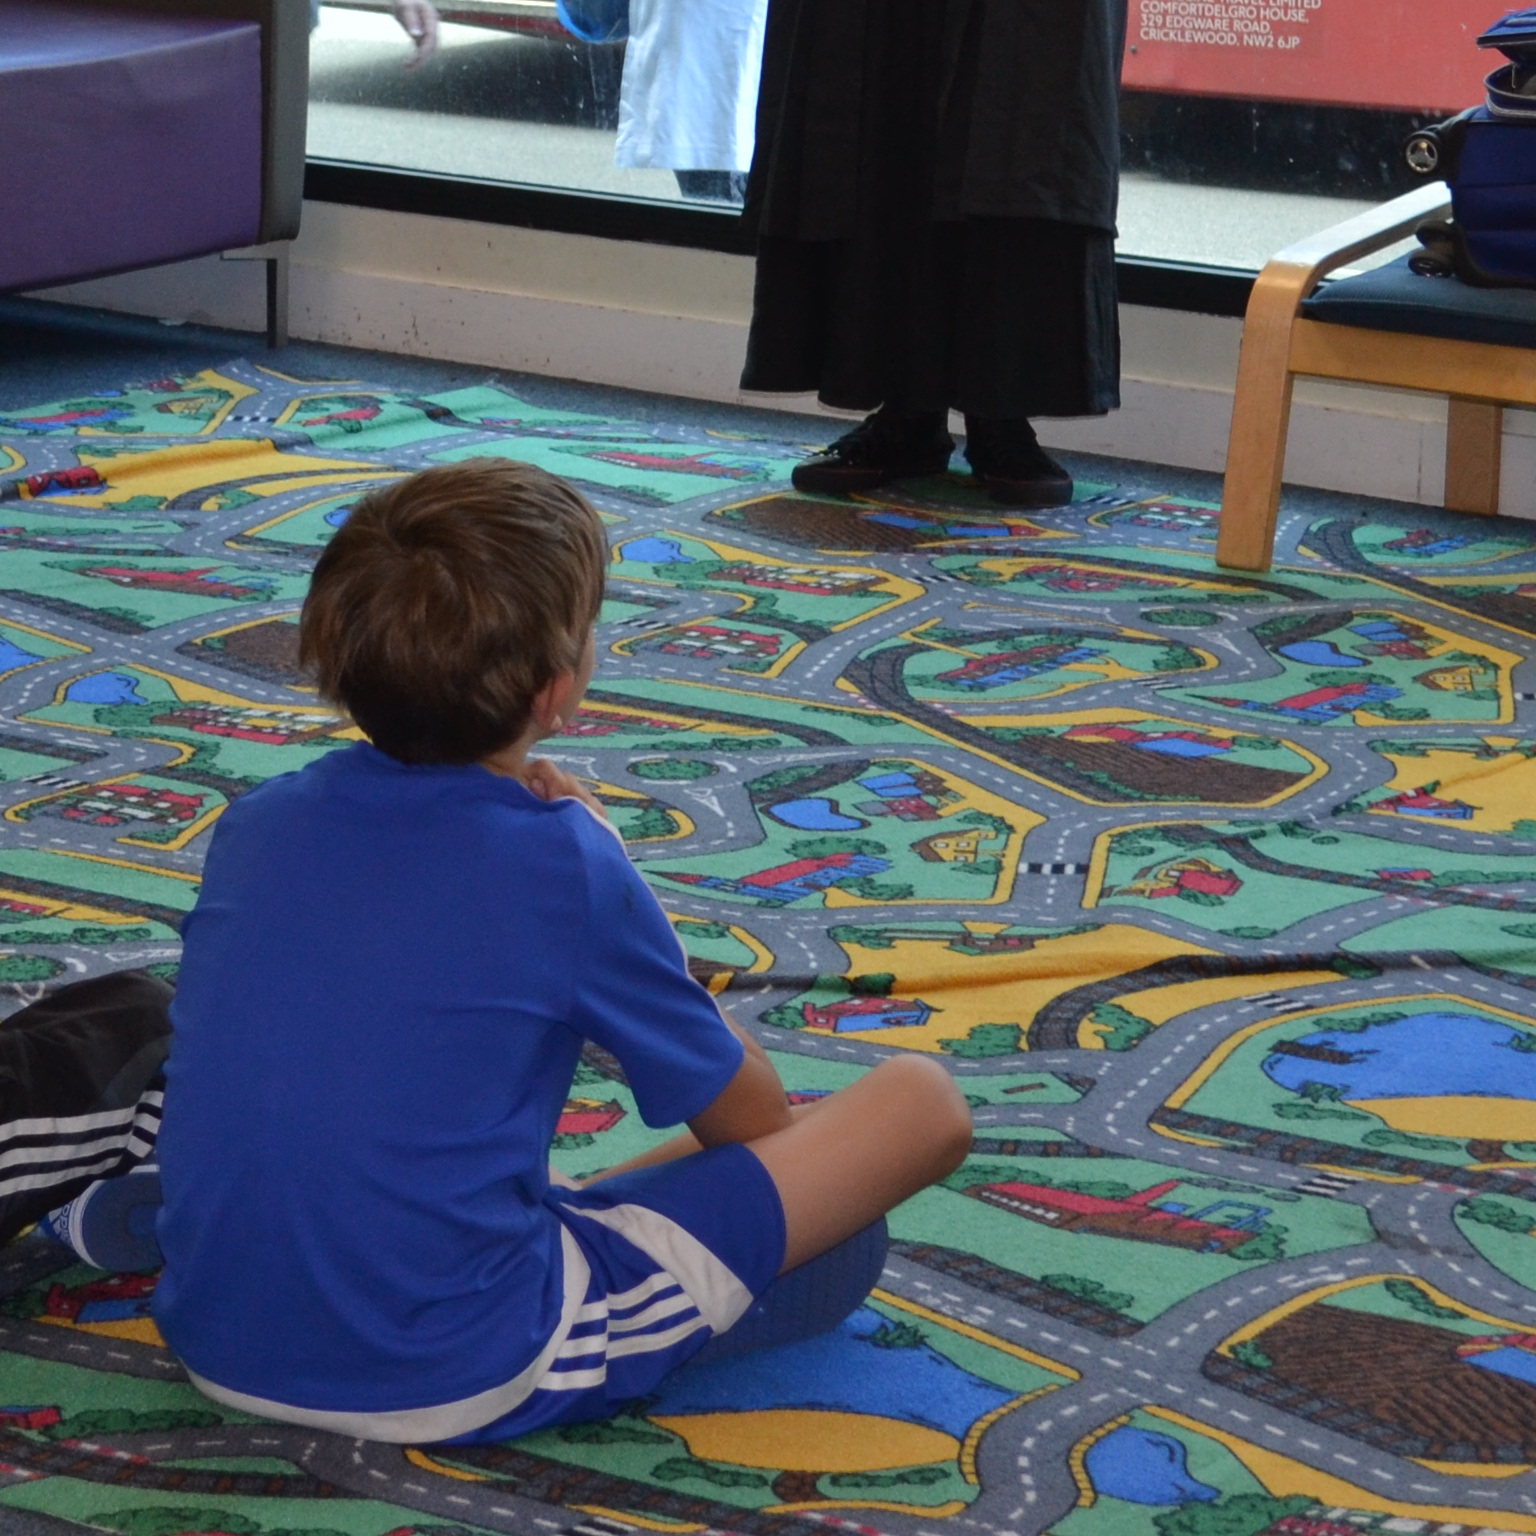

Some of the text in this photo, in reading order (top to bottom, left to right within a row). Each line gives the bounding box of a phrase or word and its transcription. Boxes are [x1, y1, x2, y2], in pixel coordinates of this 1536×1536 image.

[1140, 1, 1257, 19] COMFORTDELGRO
[1140, 14, 1272, 35] 329 EDGWARE ROAD,
[1243, 34, 1274, 48] NW2
[1277, 35, 1300, 49] 6JP
